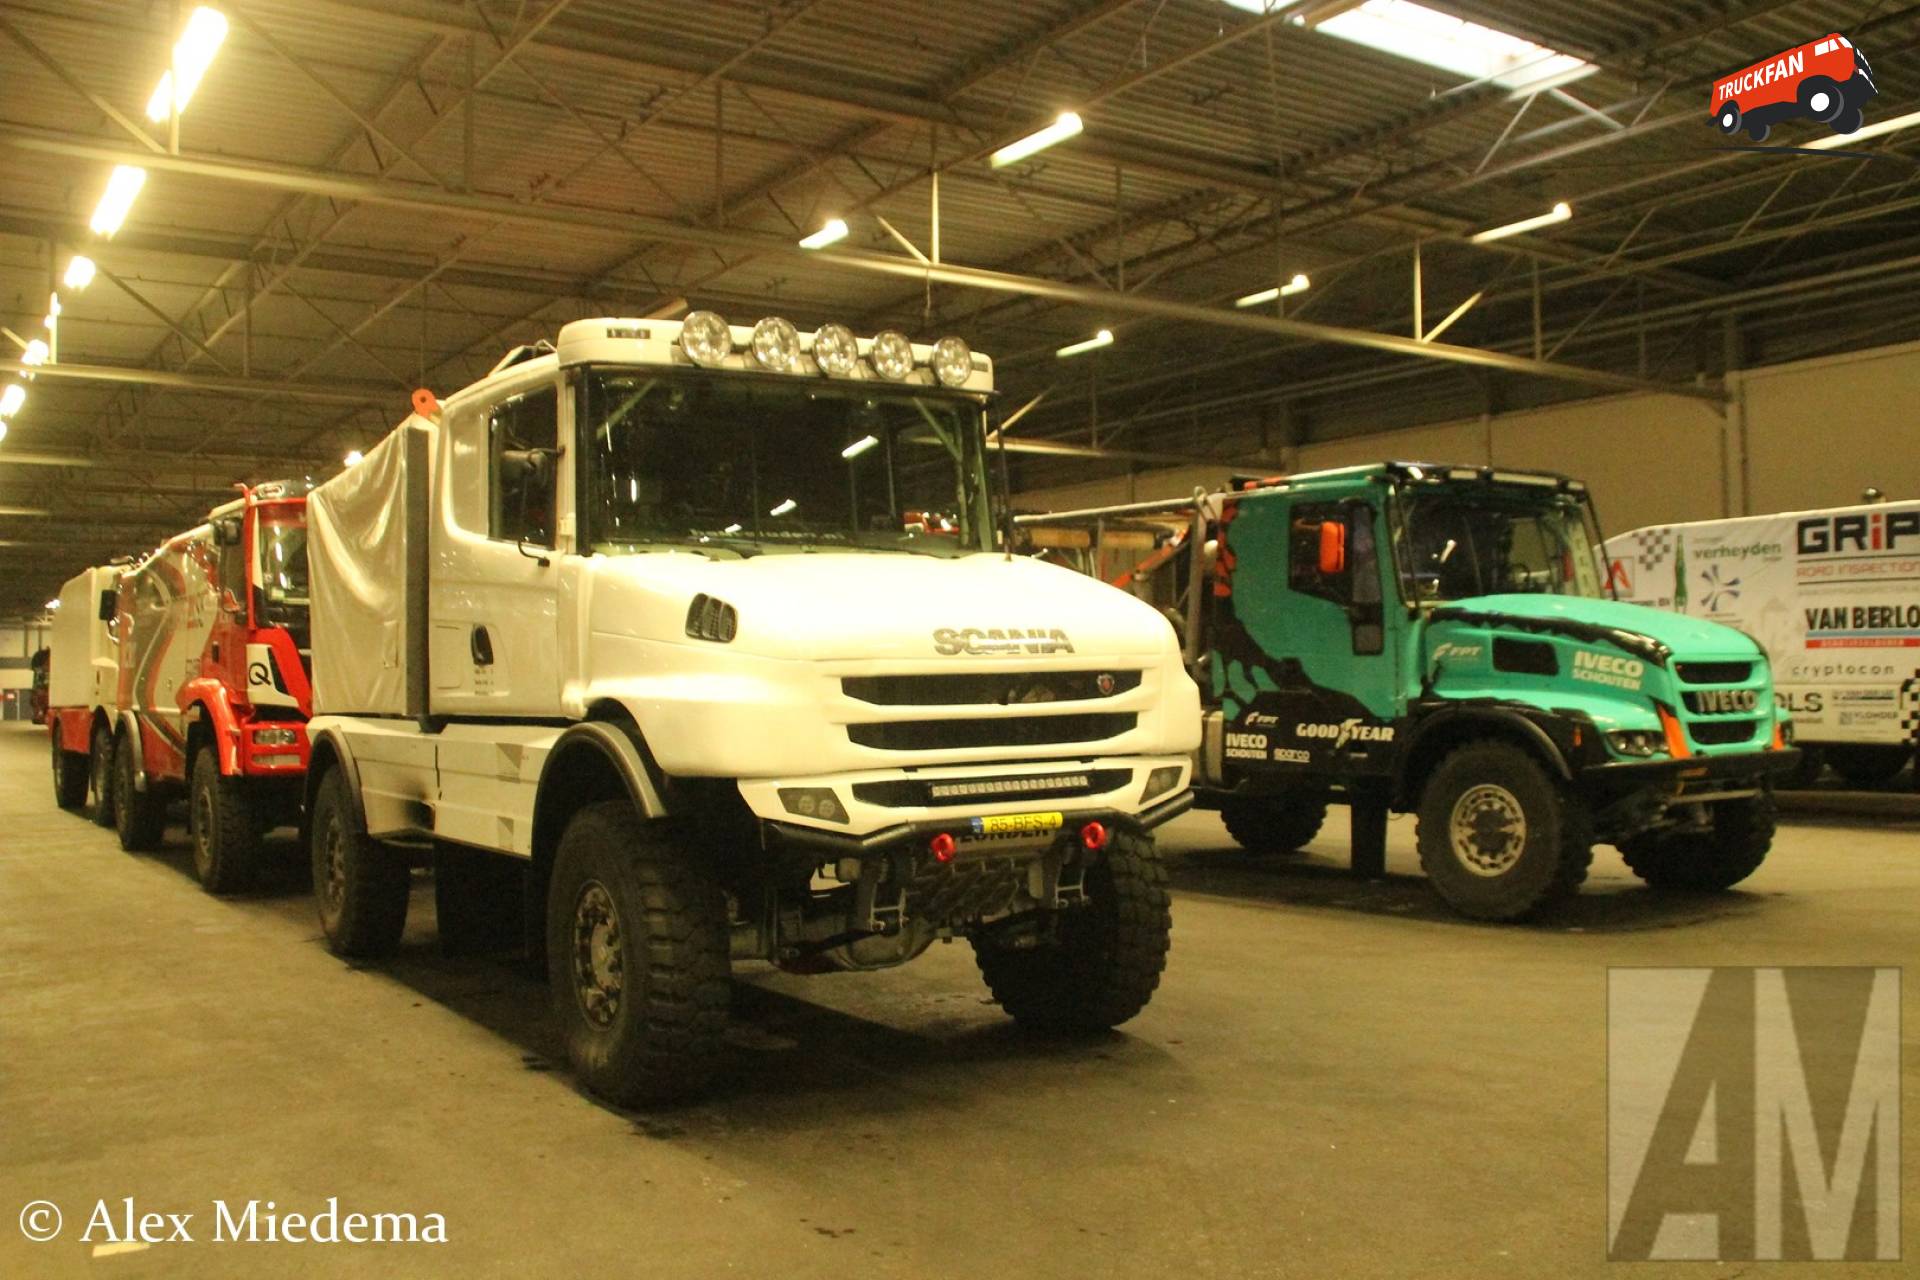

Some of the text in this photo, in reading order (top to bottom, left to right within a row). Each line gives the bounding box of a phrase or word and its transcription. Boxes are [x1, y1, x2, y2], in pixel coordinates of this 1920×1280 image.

[1694, 543, 1782, 560] verheyden
[1805, 605, 1920, 630] VAN BERLO
[933, 628, 1075, 655] SCANIA
[248, 662, 271, 685] Q
[1574, 650, 1643, 677] IVECO
[1792, 664, 1894, 677] cryptocon
[1572, 668, 1641, 690] SCHOUTEN
[1698, 690, 1758, 712] IVECO
[1226, 733, 1267, 748] IVECO
[1296, 722, 1394, 742] GOODYEAR
